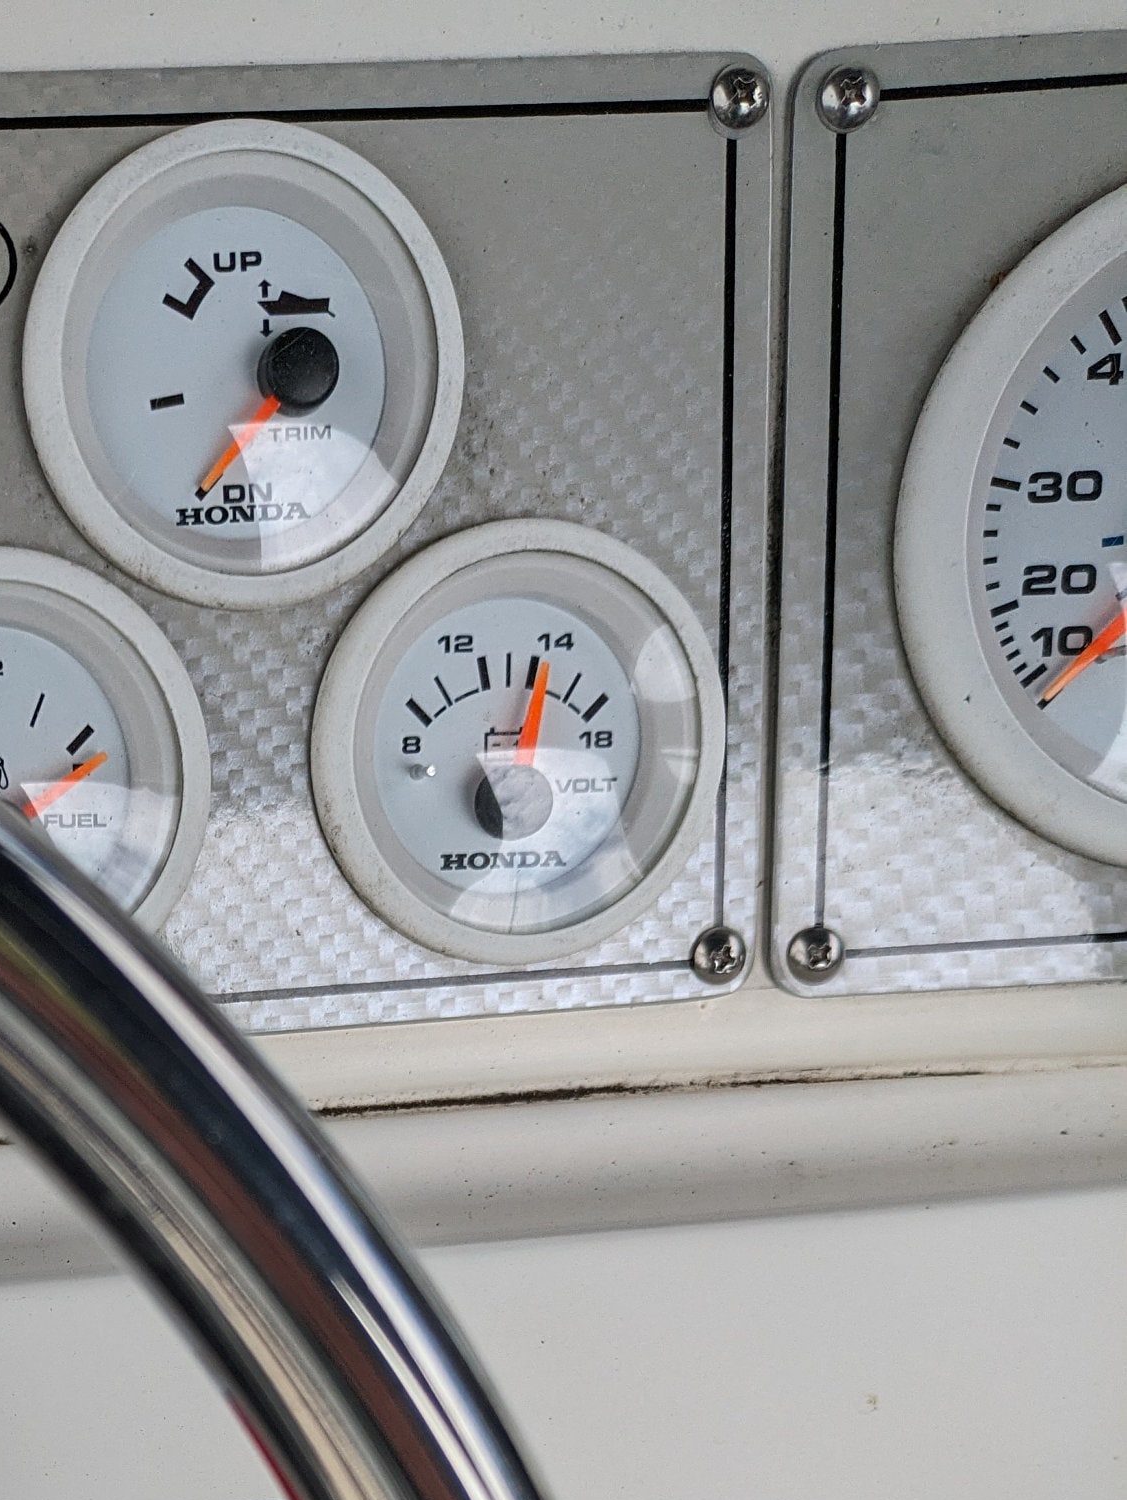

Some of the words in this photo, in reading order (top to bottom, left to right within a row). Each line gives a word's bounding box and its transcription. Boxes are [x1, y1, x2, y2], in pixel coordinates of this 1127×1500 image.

[212, 250, 263, 273] UP
[268, 424, 333, 442] TRIM
[222, 483, 274, 504] DN
[1027, 470, 1104, 504] 30
[175, 502, 311, 527] HONDA
[1021, 563, 1097, 596] 20
[437, 634, 474, 654] 12
[536, 632, 575, 652] 14
[1030, 625, 1094, 658] 10
[401, 735, 422, 755] 8
[578, 730, 614, 749] 18
[554, 776, 619, 794] VOLT
[42, 813, 108, 830] FUEL
[439, 850, 567, 871] HONDA
